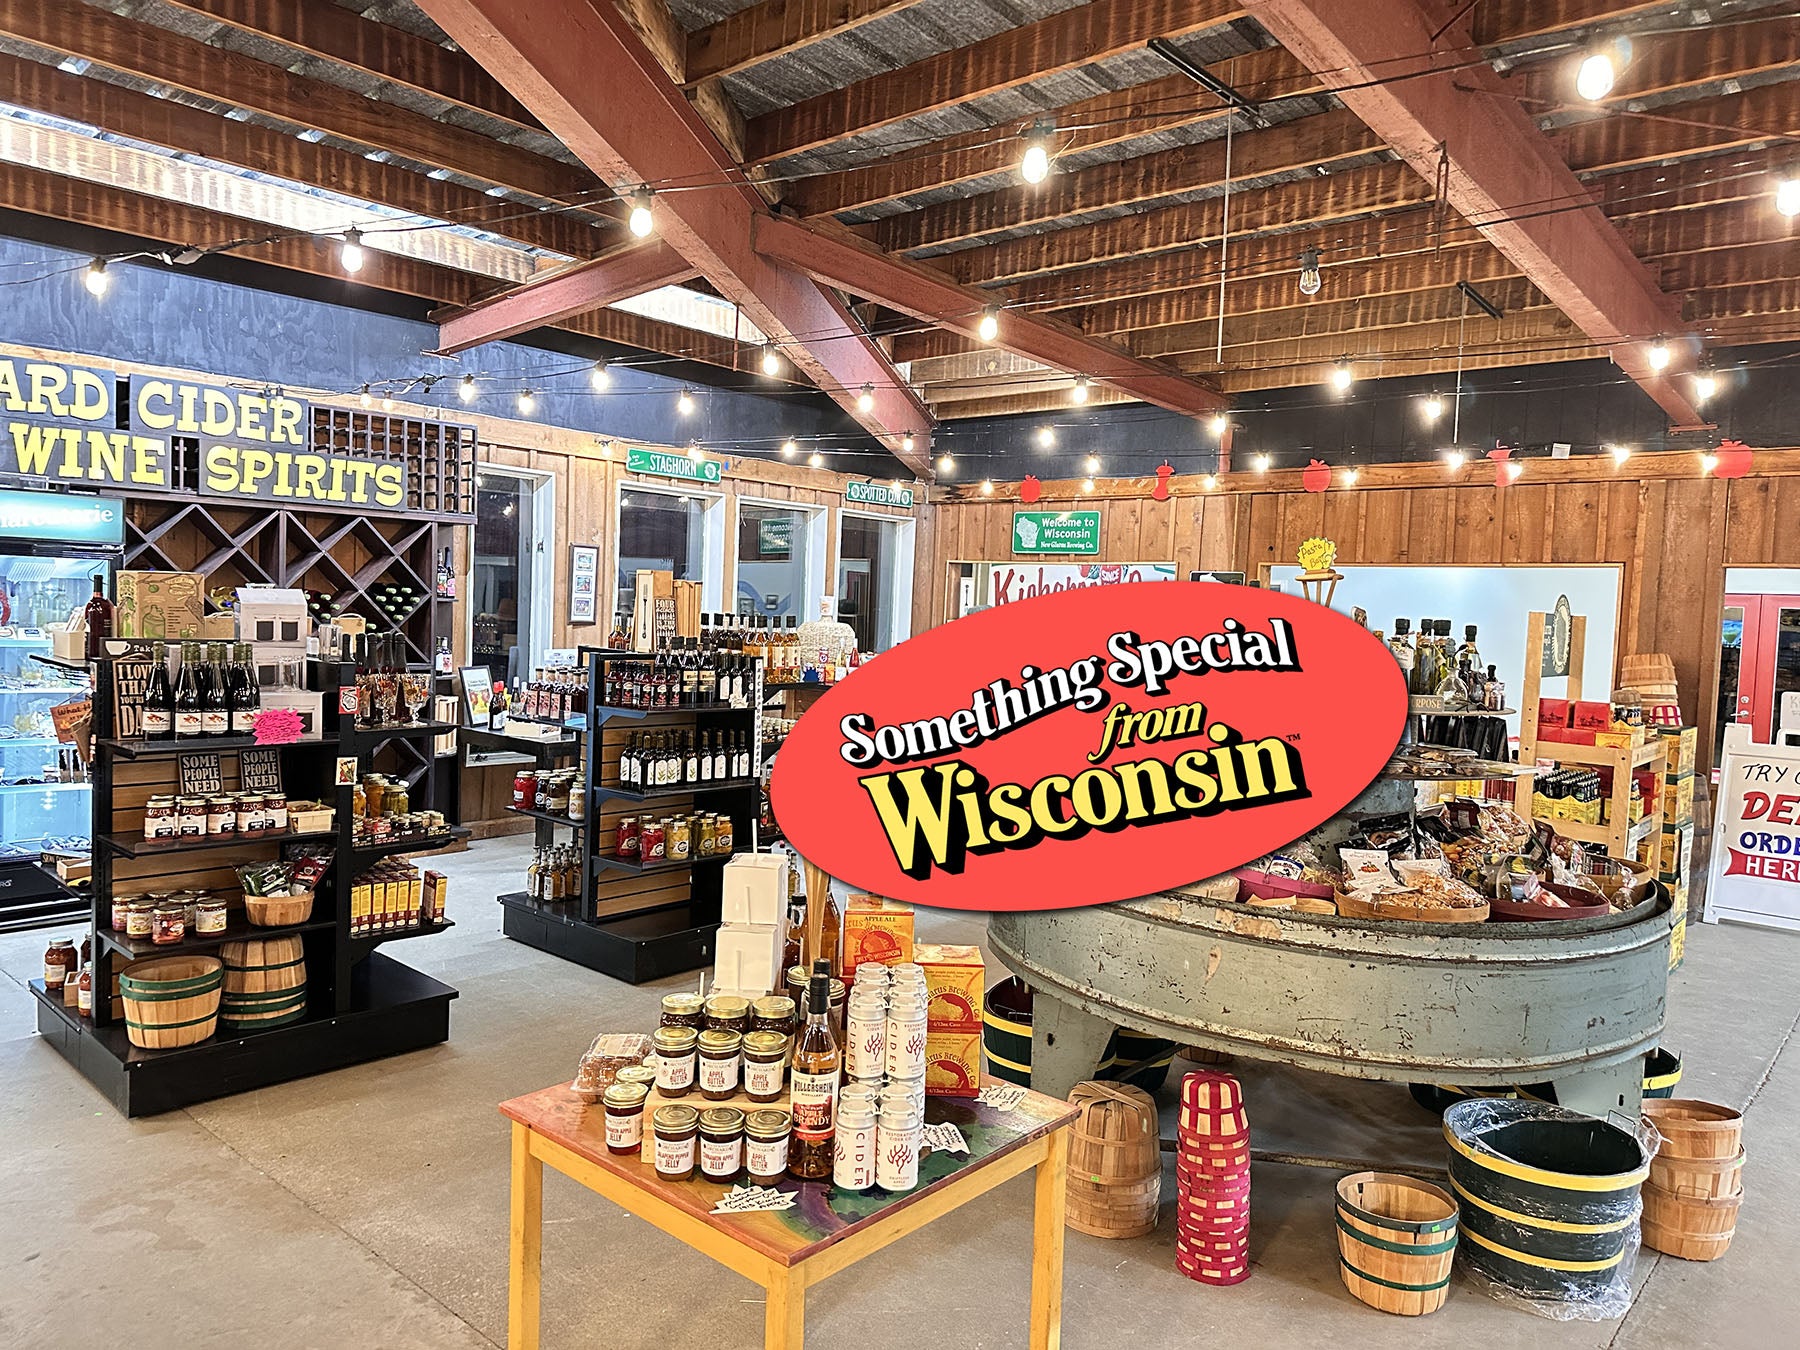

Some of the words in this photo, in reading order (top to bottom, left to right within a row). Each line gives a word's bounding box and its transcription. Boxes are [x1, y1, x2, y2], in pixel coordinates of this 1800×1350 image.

[137, 380, 304, 445] CIDER
[8, 422, 166, 485] WINE
[206, 445, 404, 507] SPIRITS
[649, 454, 697, 477] STAGHORN
[860, 485, 887, 501] SPOTTED
[1041, 517, 1082, 527] Welcome
[1084, 517, 1095, 527] to
[1044, 528, 1090, 539] Wisconsin
[1301, 543, 1323, 560] Pasta
[118, 664, 124, 679] I
[126, 664, 152, 680] LOV
[57, 706, 80, 716] What
[182, 755, 218, 768] SOME
[243, 750, 276, 764] SOME
[184, 768, 220, 781] PEOPLE
[244, 762, 277, 776] PEOPLE
[1742, 763, 1789, 783] TRY
[185, 780, 220, 794] NEED
[245, 774, 278, 788] NEED
[1740, 791, 1800, 826] DE
[1746, 855, 1800, 881] HER
[848, 1021, 857, 1072] CIDER
[888, 1022, 898, 1073] CIDER
[669, 1074, 688, 1083] BUTTER
[671, 1068, 687, 1076] APPLE
[709, 1070, 723, 1078] APPLE
[753, 1073, 768, 1081] APPLE
[707, 1077, 725, 1085] BUTTER
[751, 1080, 769, 1089] BUTTER
[794, 1112, 831, 1126] BRANDY
[802, 1109, 824, 1118] APPLE
[610, 1132, 622, 1141] JELLY
[752, 1152, 766, 1160] APPLE
[854, 1132, 866, 1187] CIDER
[664, 1159, 680, 1168] JELLY
[709, 1161, 724, 1170] JELLY
[750, 1159, 768, 1169] BUTTER
